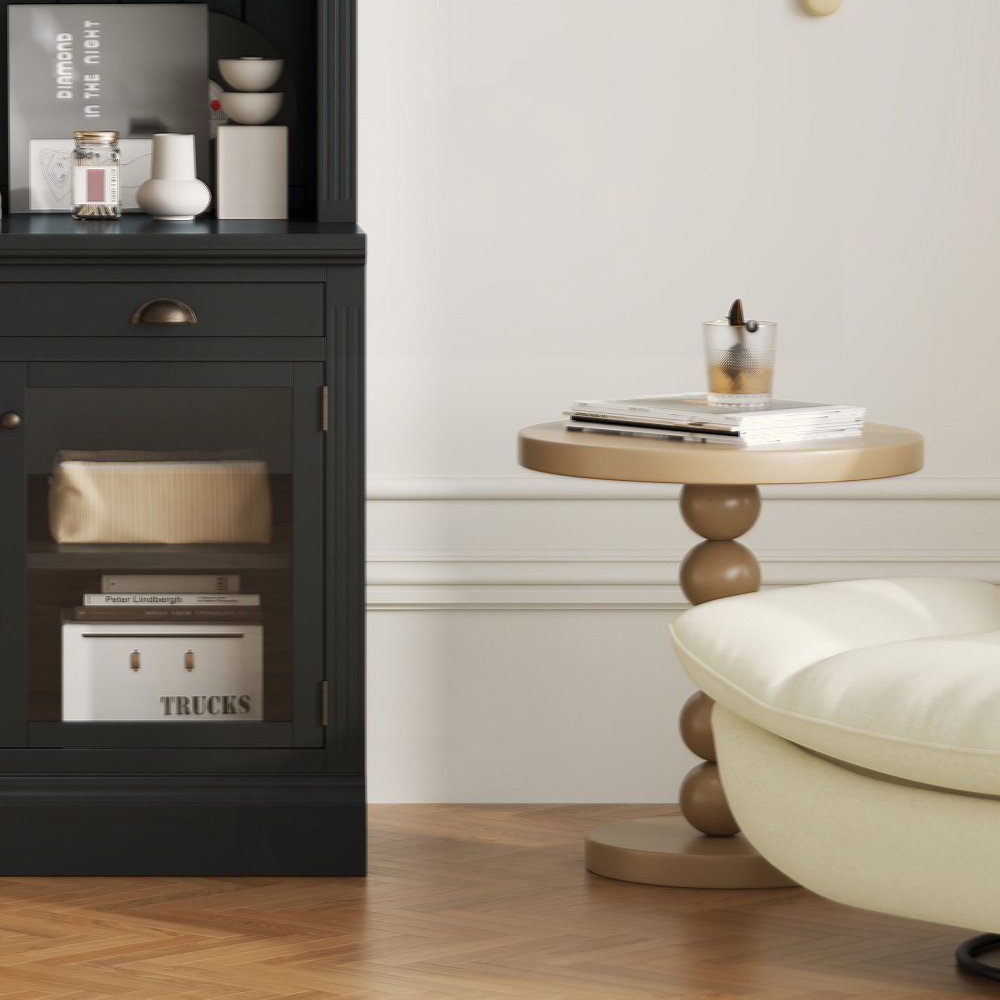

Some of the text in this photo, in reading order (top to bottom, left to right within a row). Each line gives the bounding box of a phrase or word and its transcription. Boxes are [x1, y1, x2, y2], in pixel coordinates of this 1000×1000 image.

[83, 20, 101, 64] NIGHT
[56, 32, 74, 99] DIAMOND
[83, 73, 101, 99] THE
[104, 595, 183, 604] Peter Lindbergh
[159, 694, 252, 716] TRUCKS
